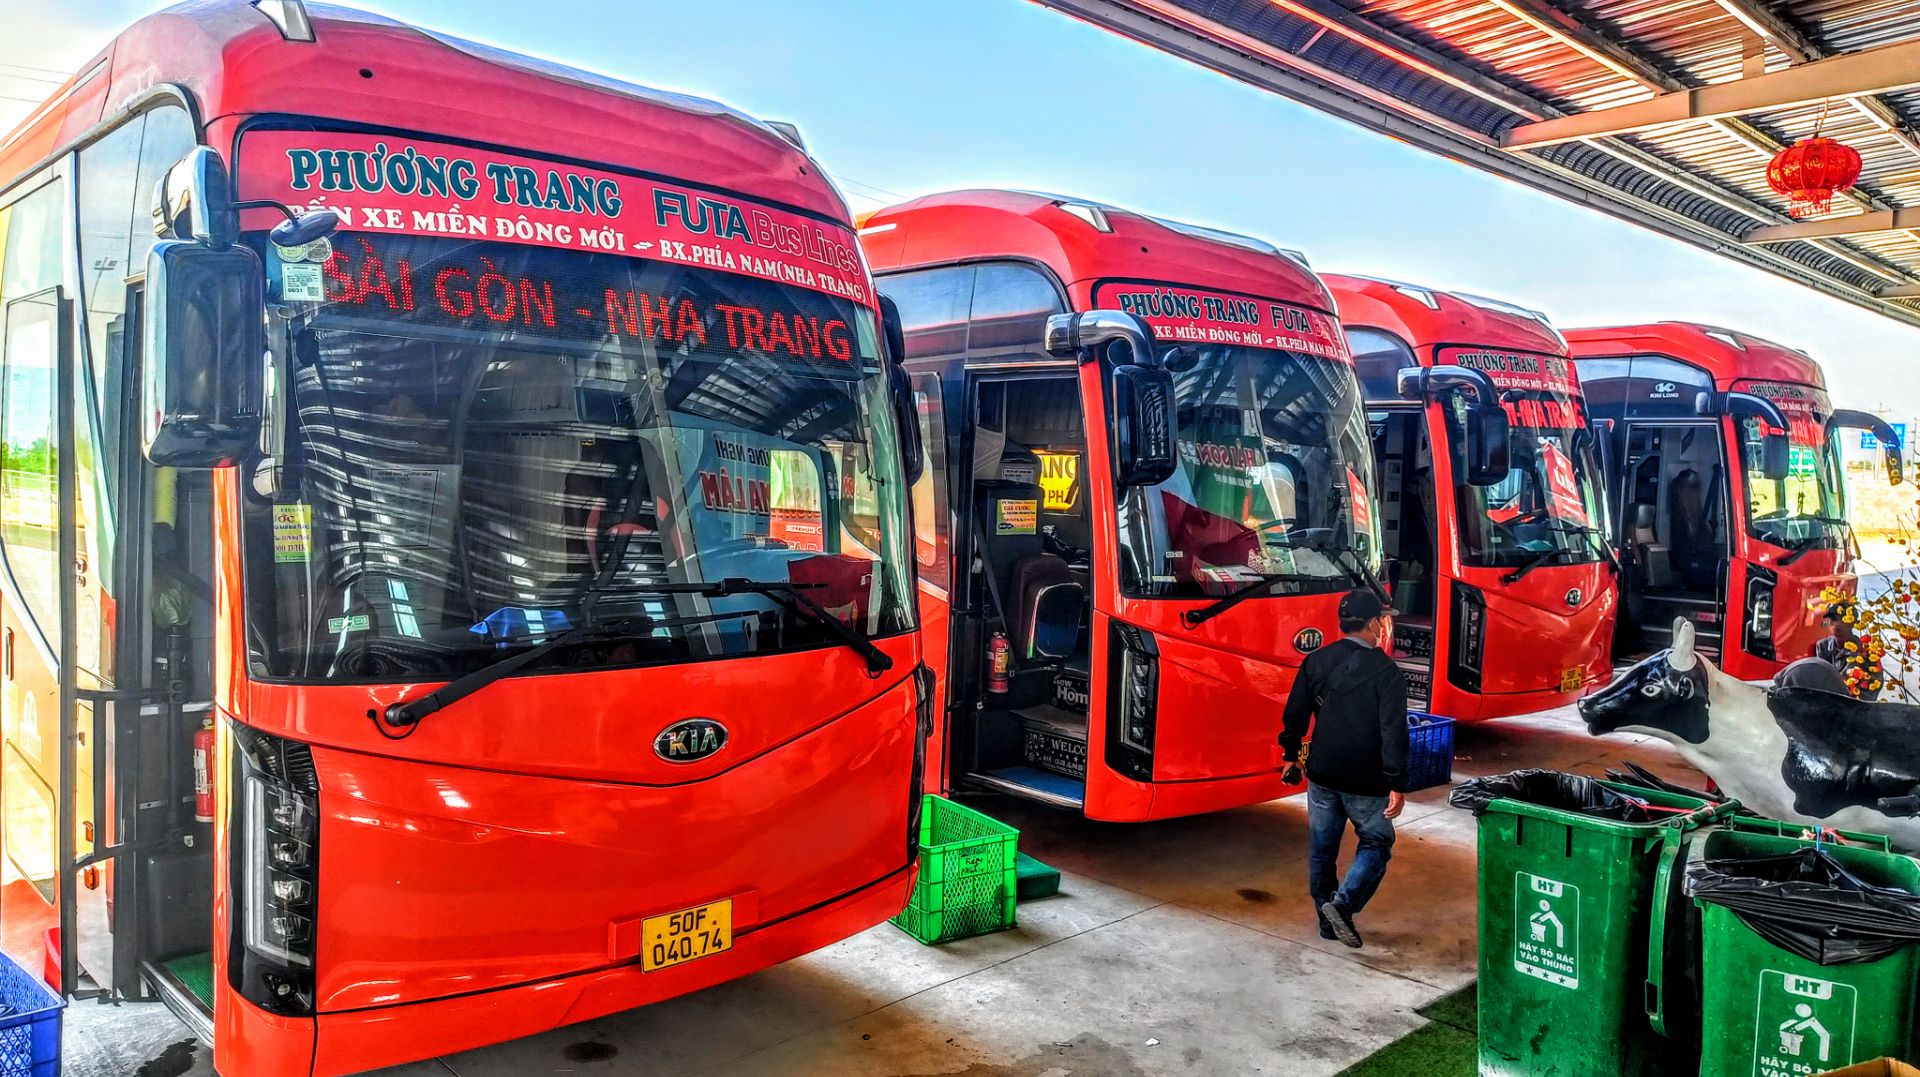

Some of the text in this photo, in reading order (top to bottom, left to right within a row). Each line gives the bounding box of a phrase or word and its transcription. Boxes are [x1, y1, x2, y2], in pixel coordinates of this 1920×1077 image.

[286, 142, 480, 200] PHƯƠNG
[486, 162, 622, 218] TRANG
[652, 188, 754, 244] FUTA
[361, 207, 405, 229] XE
[412, 203, 487, 236] MIỀN
[495, 214, 573, 244] ĐÔNG
[578, 225, 626, 251] MỚI
[324, 238, 415, 310] SÀI
[434, 256, 557, 327] GÒN
[604, 288, 707, 344] NHA
[715, 304, 851, 360] TRANG
[1117, 288, 1201, 319] PHƯƠNG
[1202, 296, 1260, 326] TRANG
[1270, 305, 1313, 334] FUTA
[1154, 325, 1173, 338] XE
[1175, 321, 1206, 340] MIỀN
[1209, 326, 1240, 343] ĐÔNG
[1243, 330, 1263, 345] MỚI
[1456, 350, 1506, 373] PHƯƠNG
[1508, 355, 1540, 374] TRANG
[1300, 633, 1320, 649] KIA
[668, 726, 718, 756] KIA
[1538, 880, 1555, 893] HT
[669, 908, 708, 937] 50F
[653, 928, 723, 967] 040.74
[1540, 947, 1553, 958] BỎ
[1556, 953, 1574, 964] RÁC
[1520, 950, 1573, 973] VÀO THÙNG
[1794, 978, 1821, 994] HT
[1760, 1056, 1788, 1069] HÃY
[1793, 1062, 1812, 1074] BỎ
